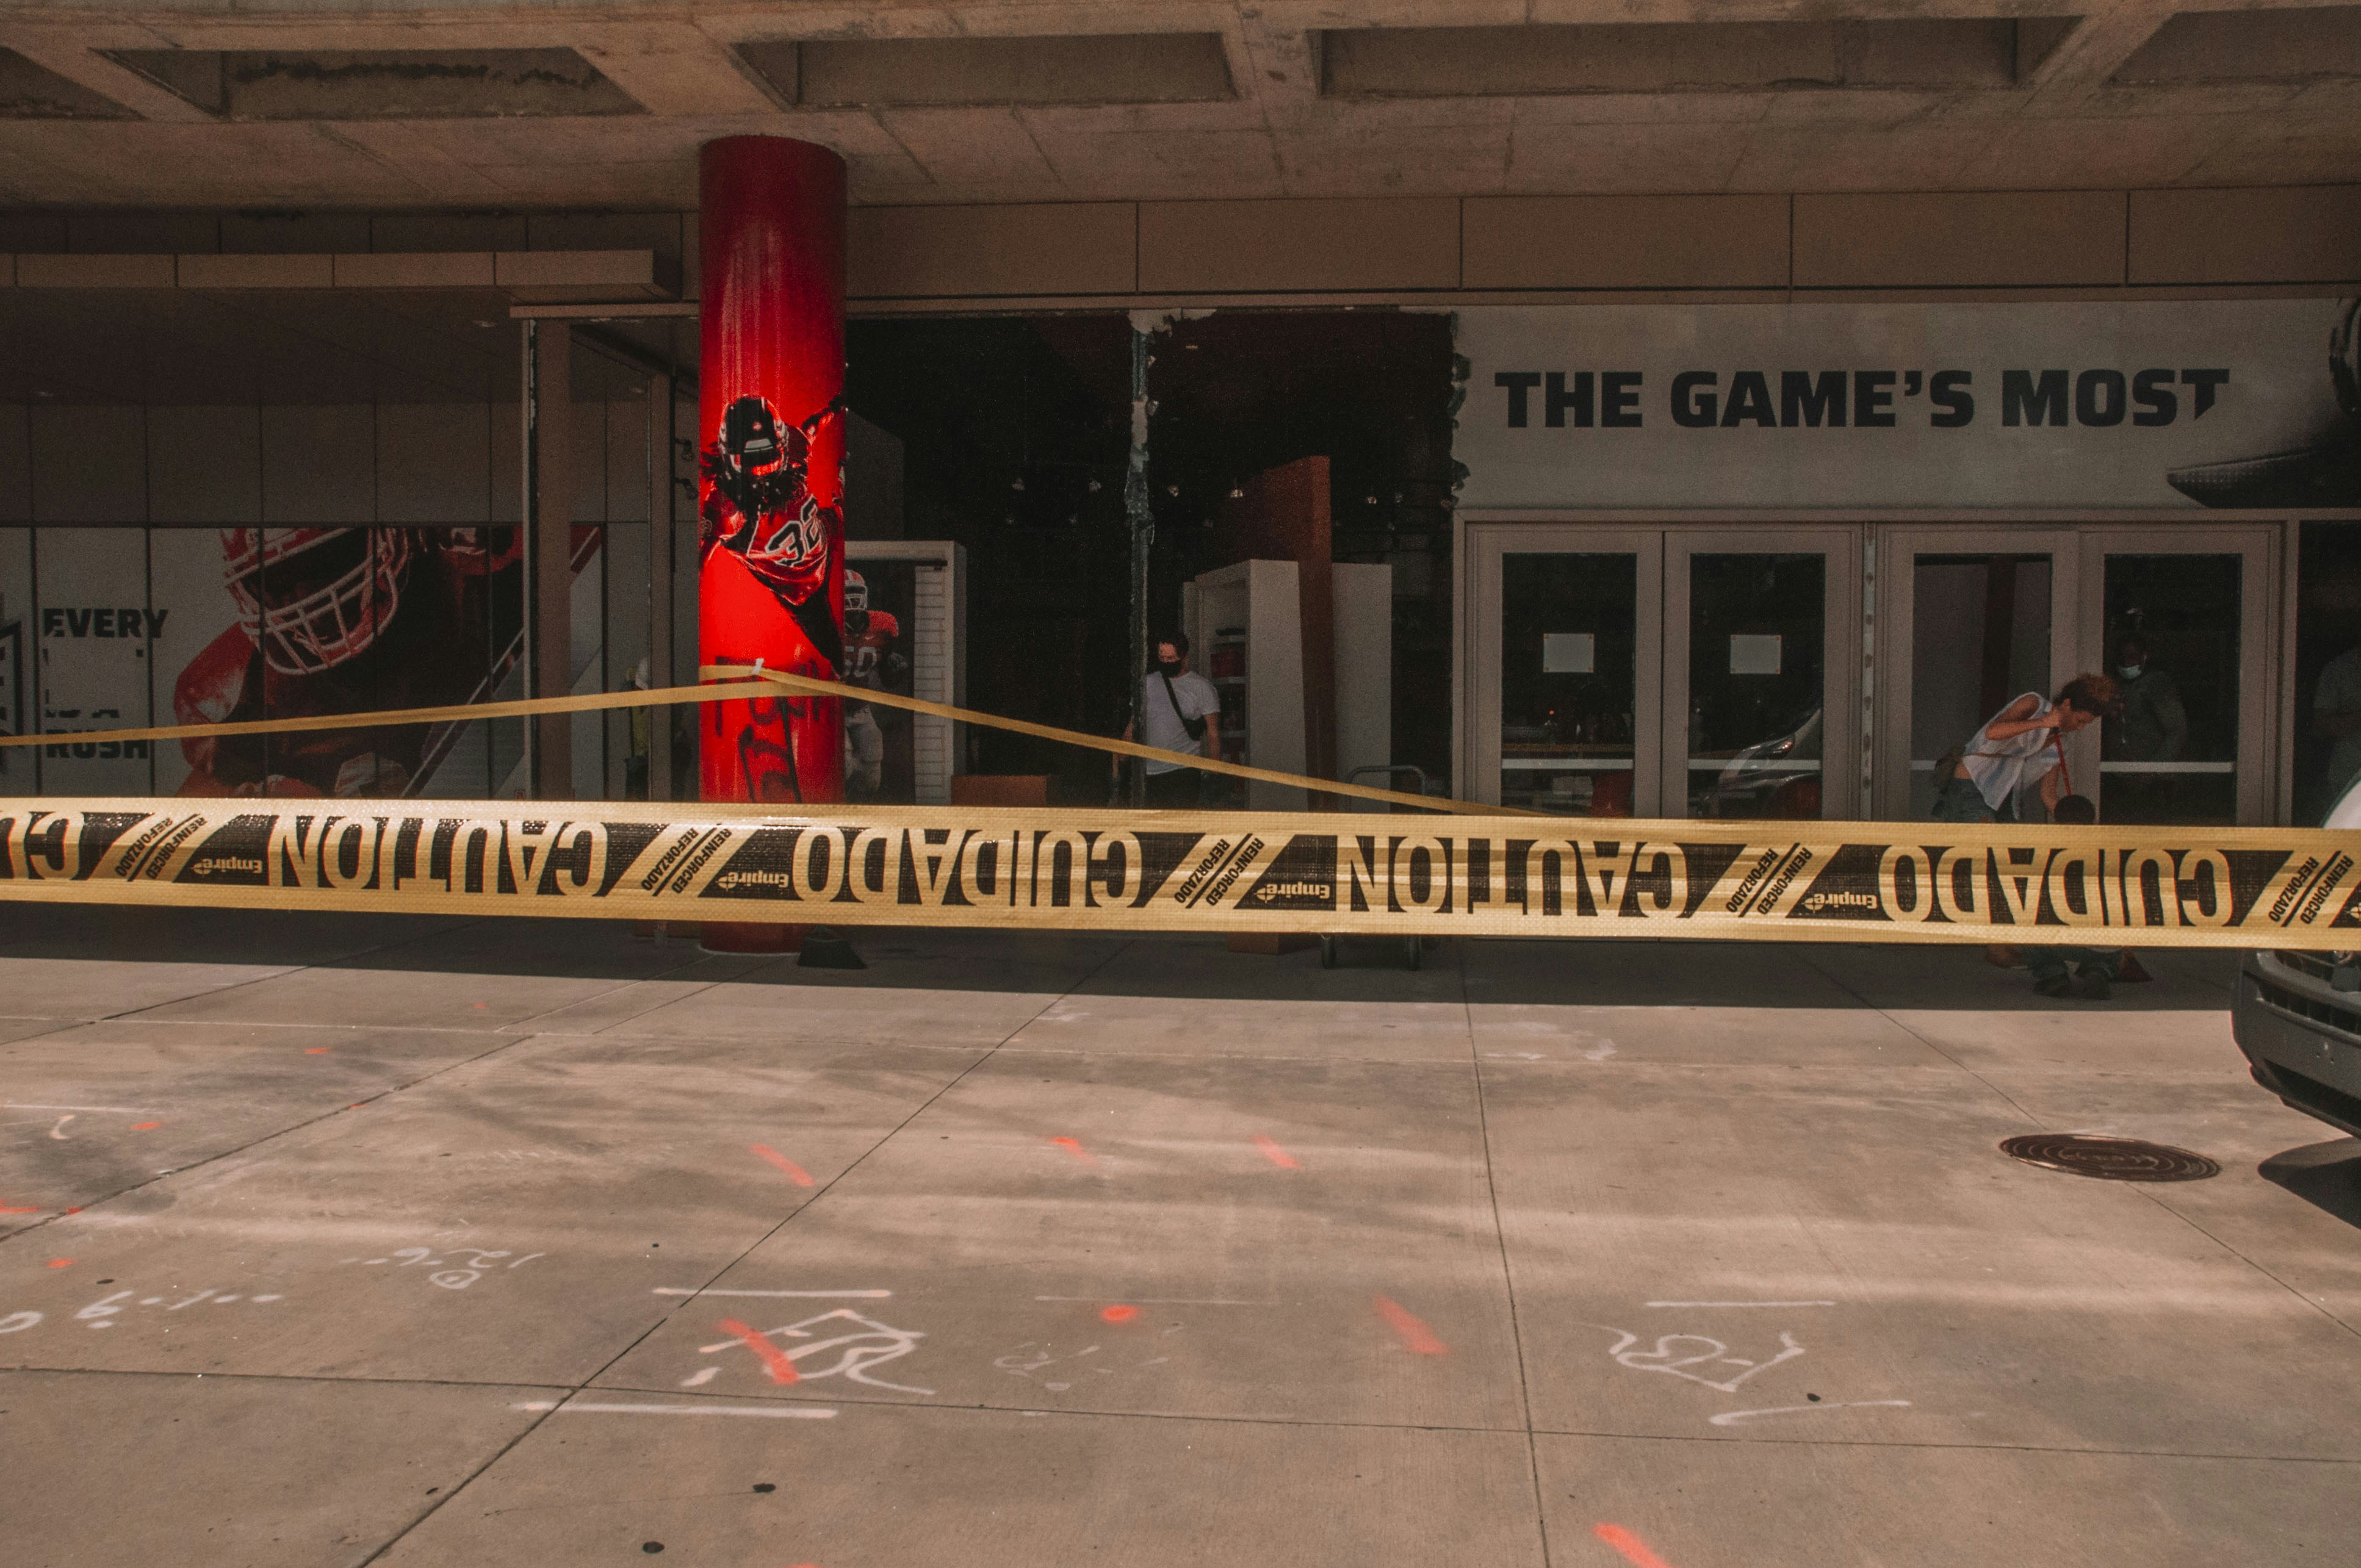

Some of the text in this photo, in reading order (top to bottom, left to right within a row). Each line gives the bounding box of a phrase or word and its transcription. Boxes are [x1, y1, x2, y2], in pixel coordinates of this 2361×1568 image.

[1494, 368, 2230, 428] THE GAME'S MOST
[43, 608, 168, 638] EVERY
[46, 728, 149, 758] RUSH
[204, 858, 263, 874] Empire
[267, 815, 608, 897] CAUTION
[640, 828, 699, 891] REFORZADO
[671, 827, 732, 894] REINFORCED
[732, 871, 789, 888] Empire
[792, 825, 1142, 907] CUIDADO
[1173, 838, 1230, 904] REFORZADO
[1206, 837, 1265, 907] REINFORCED
[1336, 835, 1688, 919] CAUTION
[1725, 848, 1778, 913] REFORZADO
[1757, 847, 1813, 916] REINFORCED
[1878, 844, 2233, 927] CUIDADO
[1266, 880, 1330, 899] Empire
[1813, 891, 1878, 909] Empire
[2268, 856, 2319, 923] REFORZADO
[2300, 855, 2354, 925] REINFORCED
